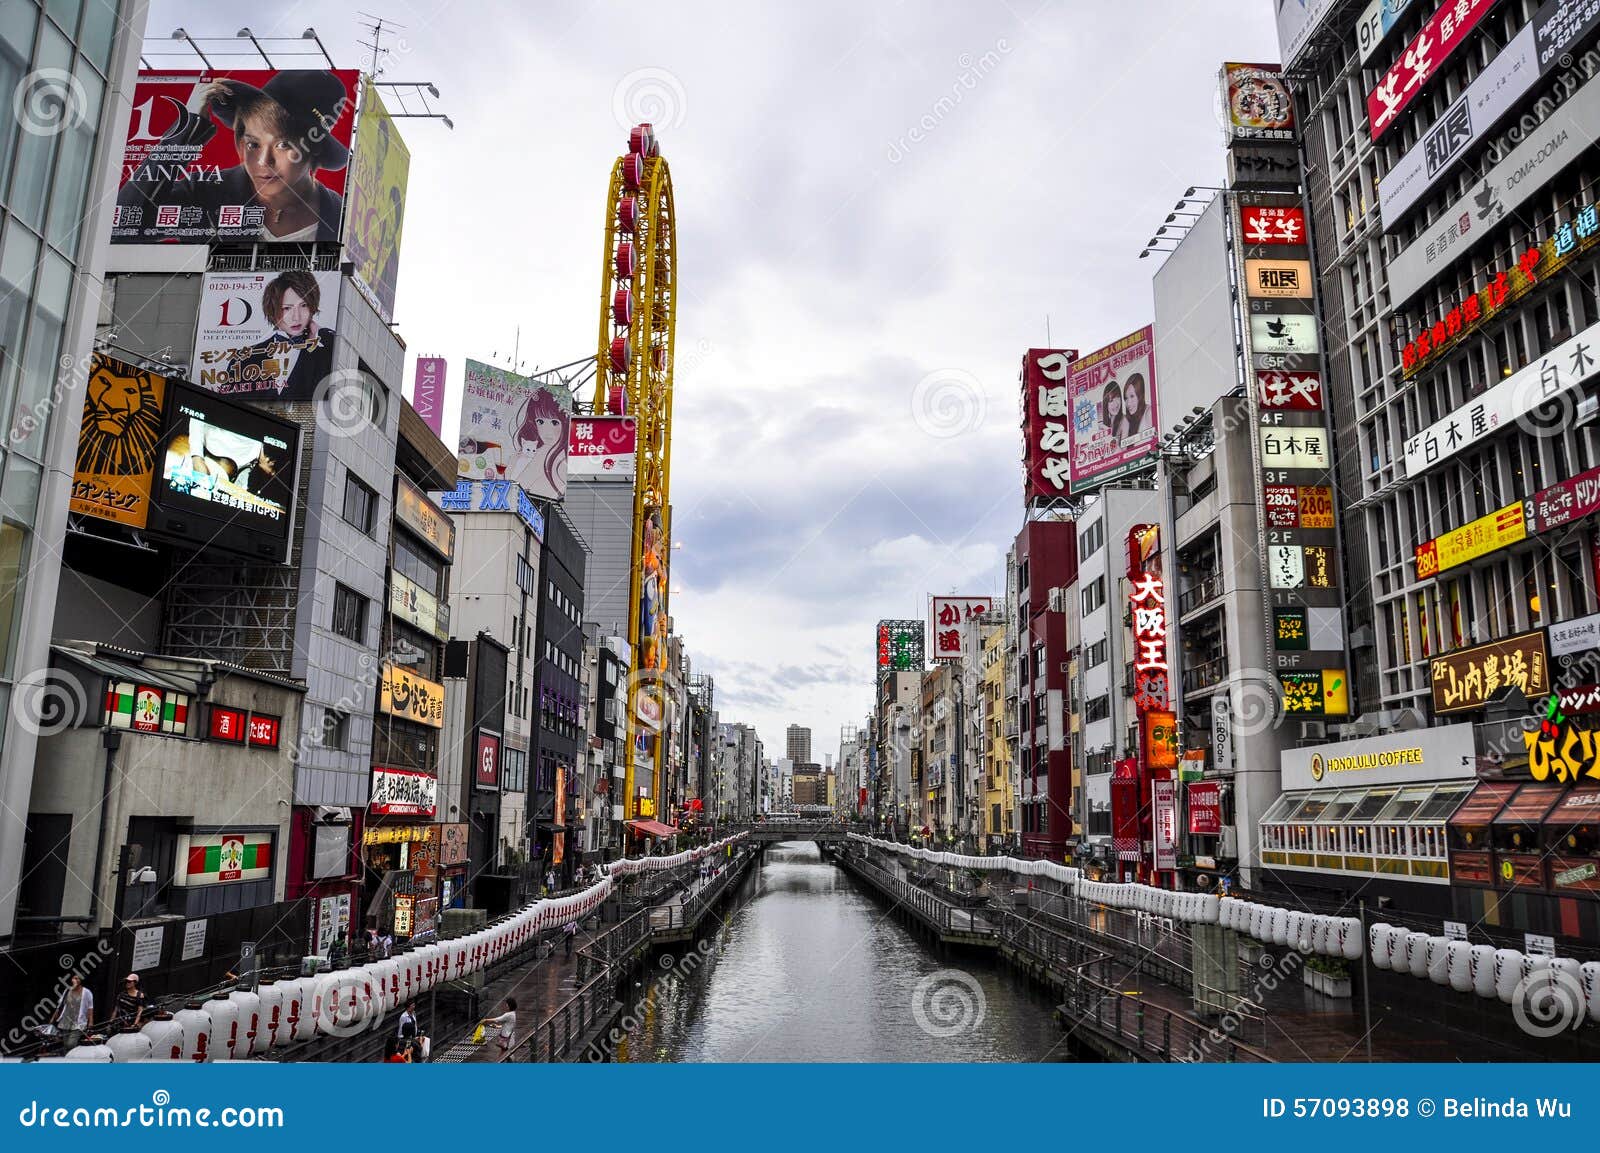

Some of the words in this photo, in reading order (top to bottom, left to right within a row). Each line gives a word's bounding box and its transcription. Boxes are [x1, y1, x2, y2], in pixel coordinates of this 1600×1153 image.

[1361, 12, 1379, 52] 9F
[1237, 126, 1252, 138] 9F
[1426, 103, 1469, 173] 和民
[1506, 129, 1569, 190] DOMA-DOMA
[218, 205, 266, 227] 最高
[209, 282, 263, 291] 0120-194-373
[1260, 270, 1297, 287] 和民
[1259, 376, 1319, 406] はや
[1407, 437, 1420, 457] 4F
[1425, 404, 1489, 464] 白木屋
[578, 442, 605, 453] Free
[1265, 434, 1323, 455] 白木屋
[1433, 661, 1448, 681] 2F
[1283, 682, 1318, 696] びっくり
[1282, 696, 1322, 712] ドンキー
[219, 715, 230, 734] 酒
[250, 721, 271, 740] たばこ
[1327, 753, 1378, 771] HONOLULU
[1379, 749, 1422, 766] COFFEE
